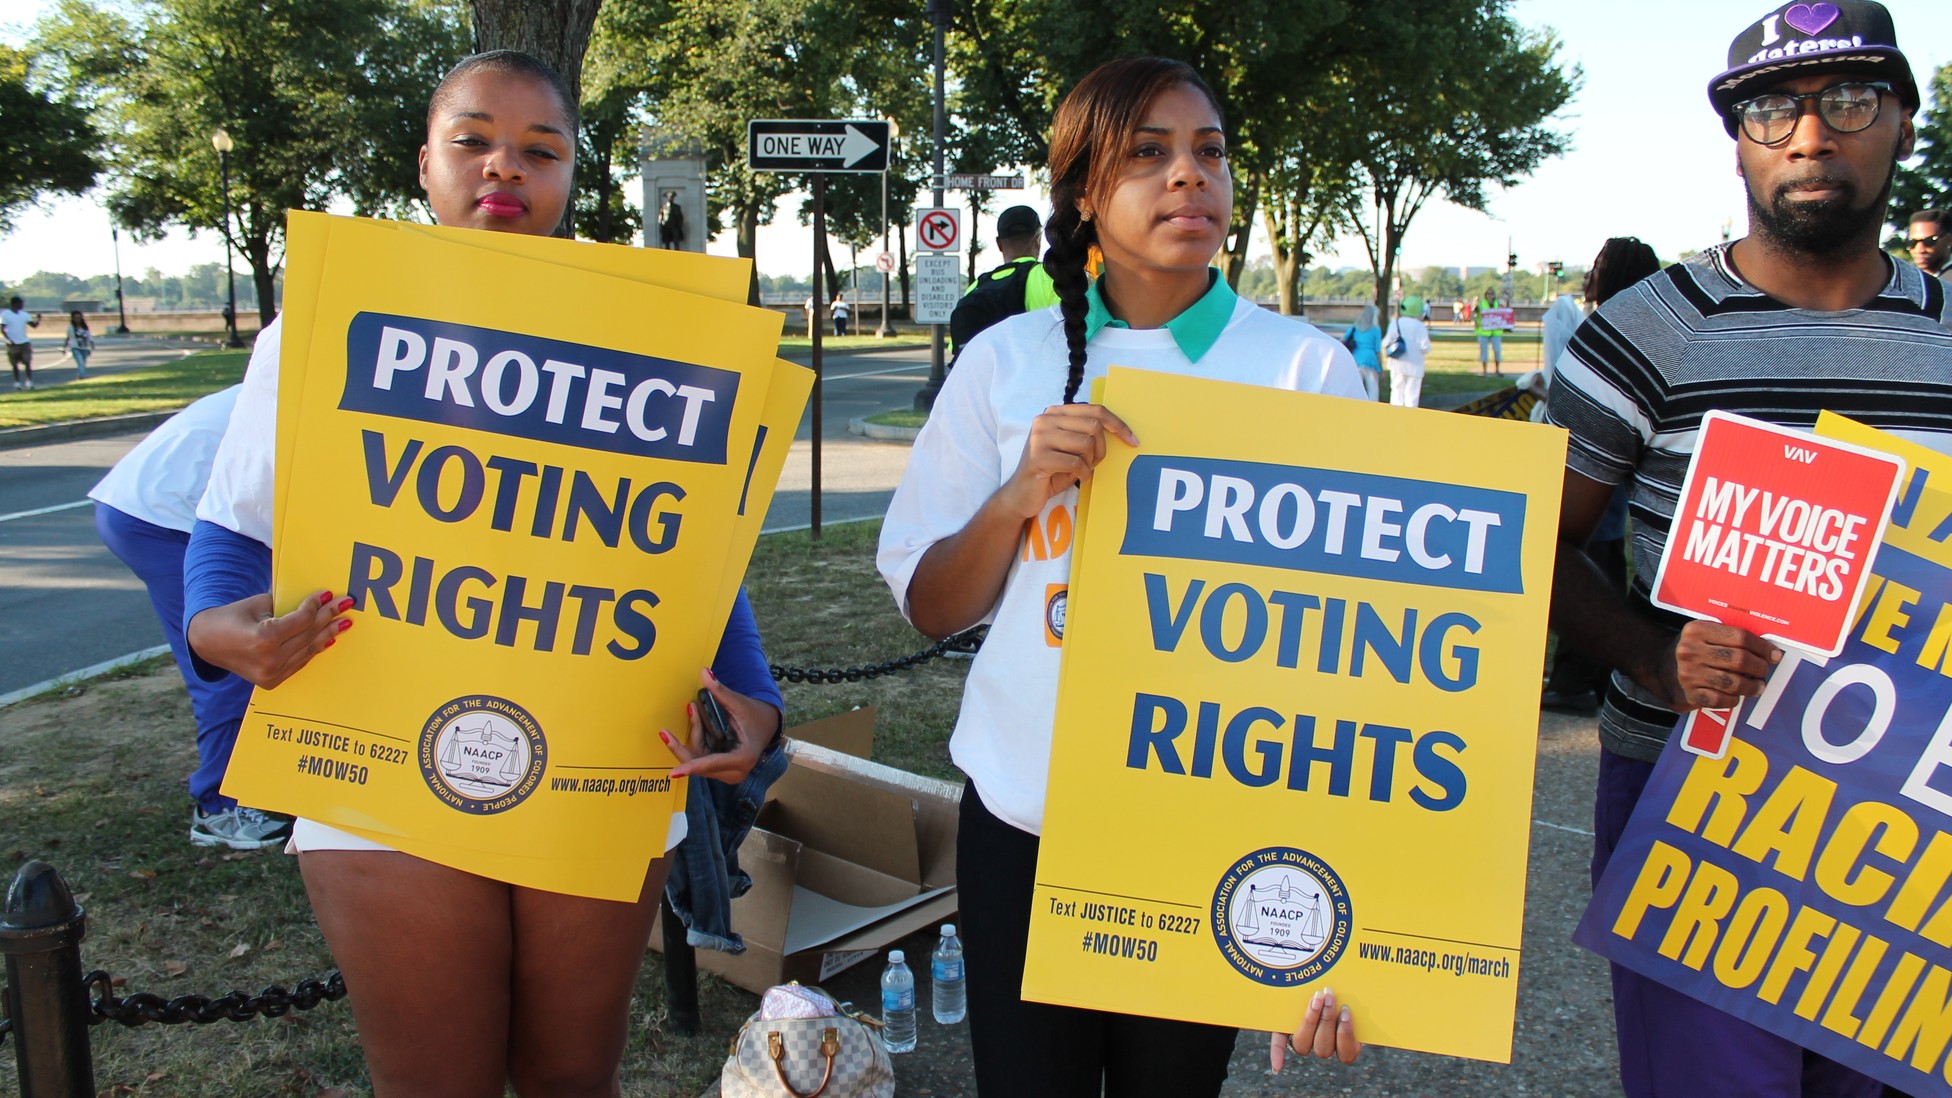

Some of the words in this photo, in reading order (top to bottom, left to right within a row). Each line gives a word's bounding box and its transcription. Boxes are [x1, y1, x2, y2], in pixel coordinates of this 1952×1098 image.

[1761, 13, 1780, 47] I
[764, 137, 801, 155] ONE
[808, 137, 846, 155] WAY
[949, 176, 974, 188] HOME
[978, 176, 1008, 188] FRONT
[1011, 176, 1024, 189] DR
[925, 260, 951, 268] EXCEPT
[921, 293, 955, 301] DISABLED
[929, 310, 946, 318] ONLY
[373, 325, 715, 446] PROTECT
[361, 429, 687, 555] VOTING
[1153, 467, 1501, 574] PROTECT
[1696, 476, 1760, 528] MY
[1759, 491, 1868, 560] VOICE
[1683, 519, 1850, 601] MATTERS
[347, 541, 661, 661] RIGHTS
[1143, 572, 1482, 693] VOTING
[442, 704, 460, 718] FOR
[463, 699, 482, 709] THE
[486, 700, 540, 741] ADVANCEMENT
[266, 724, 293, 742] Text
[297, 729, 350, 752] JUSTICE
[353, 740, 366, 756] to
[370, 744, 409, 765] 62227
[422, 716, 443, 769] ASSOCIATION
[463, 746, 503, 761] NAACP
[534, 744, 543, 756] OF
[1126, 692, 1468, 812] RIGHTS
[298, 755, 369, 785] #MOW50
[471, 765, 490, 774] 1909
[518, 760, 542, 796] COLORED
[551, 775, 671, 796] www.naacp.org/march
[429, 773, 463, 807] NATIONAL
[482, 795, 517, 811] PEOPLE
[1258, 852, 1277, 863] THE
[1665, 736, 1952, 949] RACI
[1236, 860, 1255, 876] FOR
[1282, 852, 1343, 897] ADVANCEMENT
[1049, 897, 1076, 917] Text
[1080, 902, 1136, 926] JUSTICE
[1141, 912, 1153, 928] to
[1158, 914, 1200, 935] 62227
[1216, 875, 1237, 937] ASSOCIATION
[1261, 906, 1303, 921] NAACP
[1337, 902, 1347, 916] OF
[1082, 931, 1158, 962] #MOW50
[1270, 928, 1291, 937] 1909
[1322, 921, 1347, 963] COLORED
[1224, 940, 1264, 978] NATIONAL
[1285, 961, 1323, 982] PEOPLE
[1359, 942, 1510, 978] www.naacp.org/march
[1611, 839, 1952, 1087] PROFILIN
